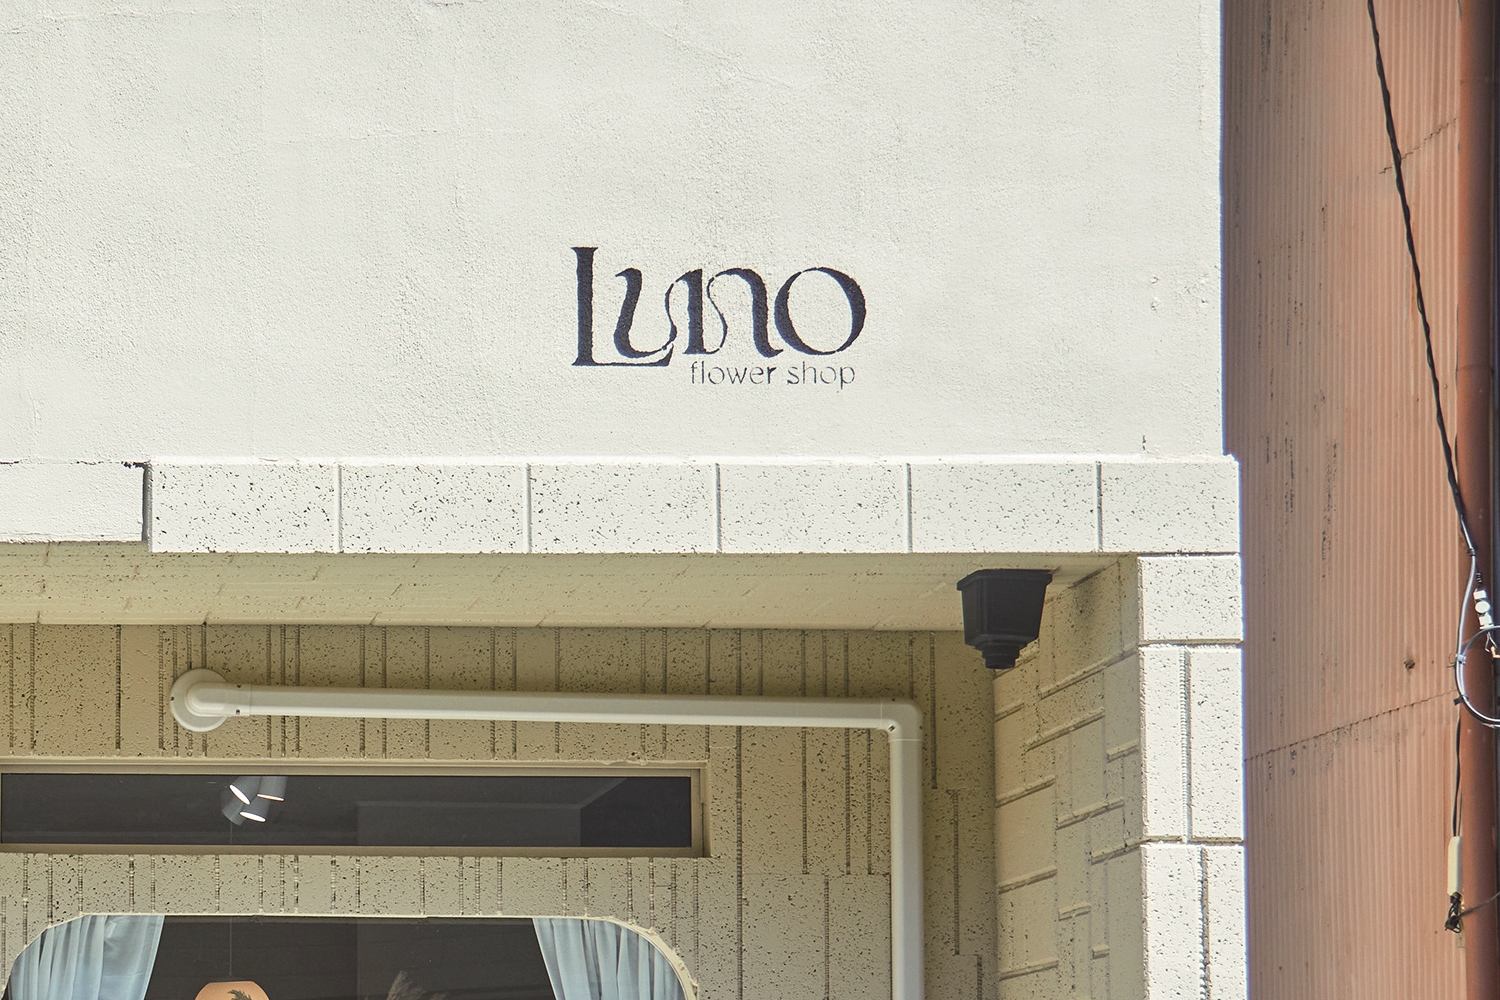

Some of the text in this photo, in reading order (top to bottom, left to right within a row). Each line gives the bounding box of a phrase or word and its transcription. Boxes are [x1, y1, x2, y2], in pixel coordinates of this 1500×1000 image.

[571, 246, 866, 366] Luno
[690, 361, 856, 390] flower shop
